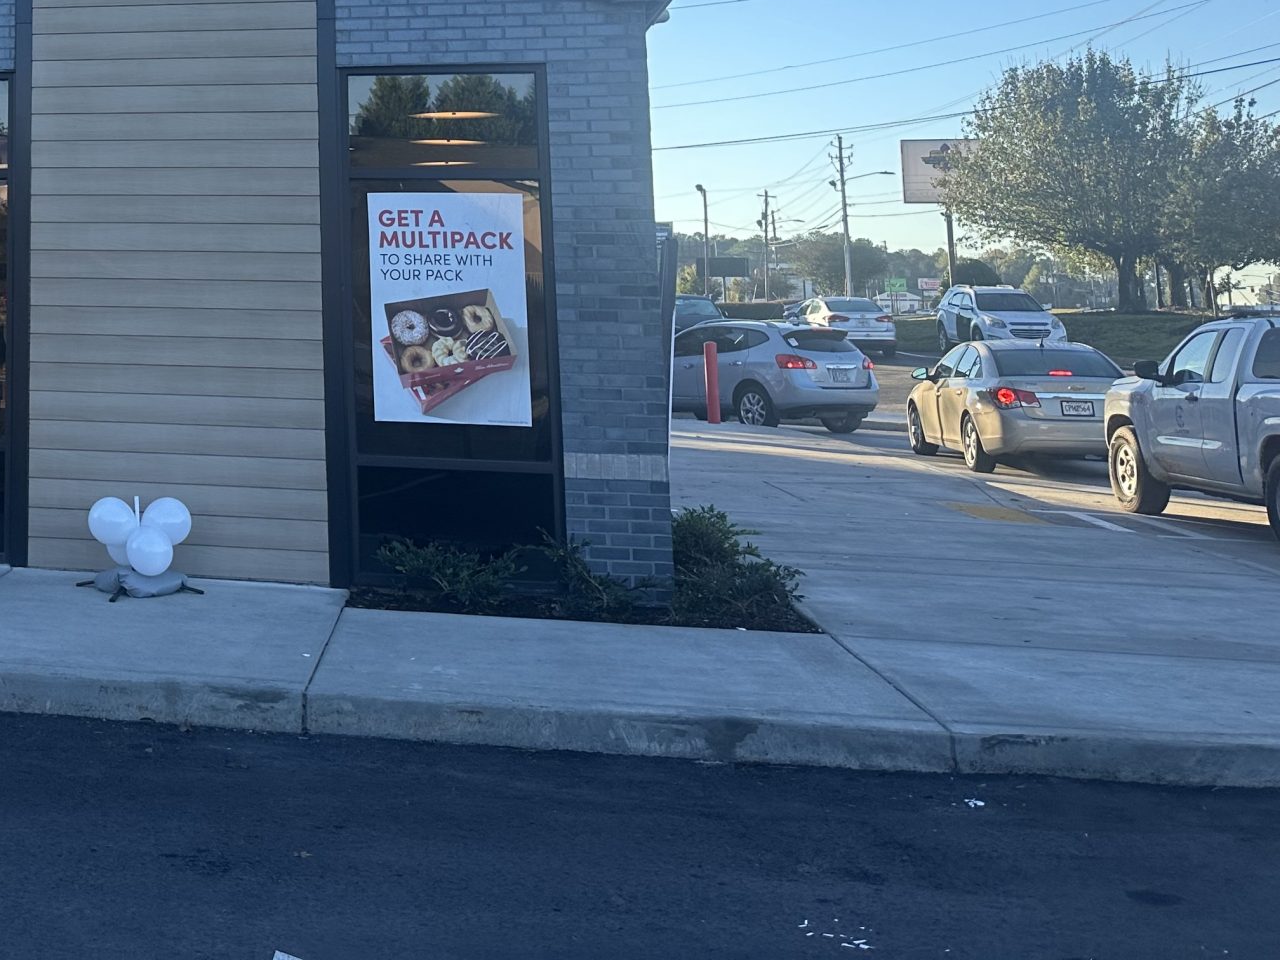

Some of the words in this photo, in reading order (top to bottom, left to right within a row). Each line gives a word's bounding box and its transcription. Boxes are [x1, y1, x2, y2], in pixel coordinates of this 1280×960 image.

[378, 209, 424, 228] GET
[428, 209, 445, 228] A
[379, 230, 514, 250] MULTIPACK
[380, 253, 400, 266] TO
[404, 253, 452, 266] SHARE
[455, 254, 493, 267] WITH
[380, 268, 421, 281] YOUR
[426, 269, 464, 282] PACK
